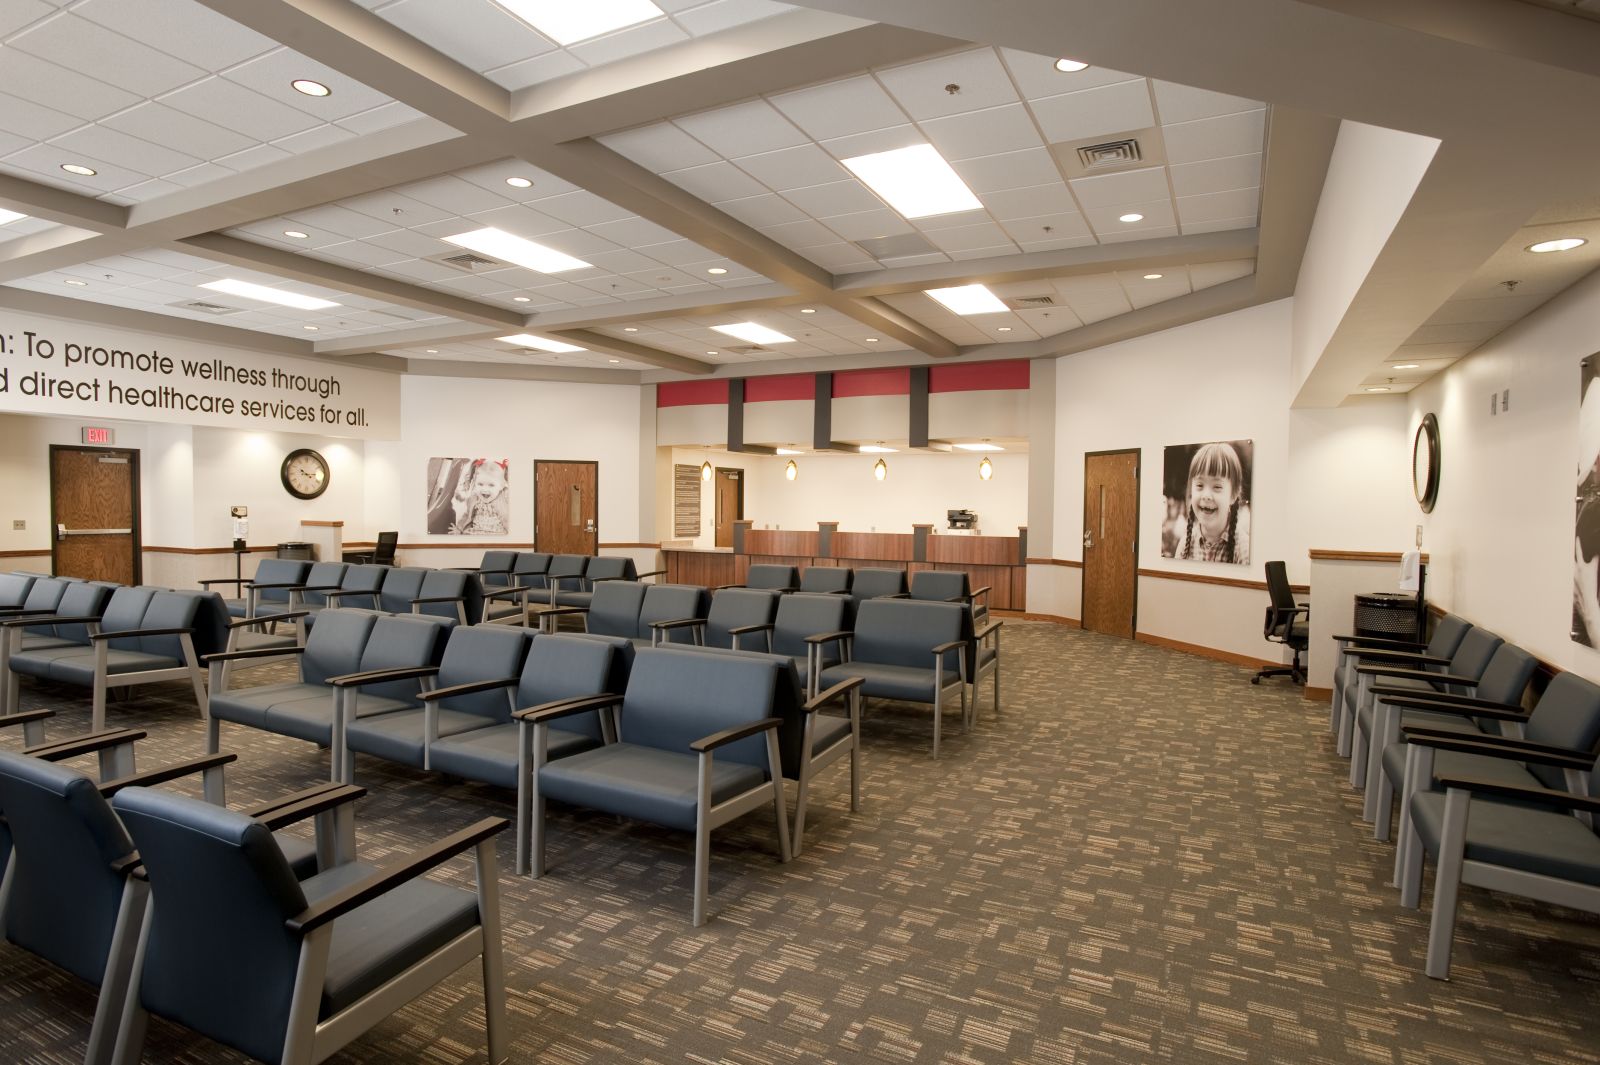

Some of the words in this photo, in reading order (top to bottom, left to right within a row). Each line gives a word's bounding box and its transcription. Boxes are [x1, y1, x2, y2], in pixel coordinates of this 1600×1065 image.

[23, 331, 55, 359] To
[65, 343, 174, 375] promote
[181, 359, 267, 387] wellness
[271, 367, 341, 399] through
[19, 371, 101, 402] direct
[108, 380, 235, 415] healthcare
[240, 399, 316, 422] services
[320, 404, 342, 425] for
[346, 407, 369, 427] all.
[88, 428, 108, 443] EXIT
